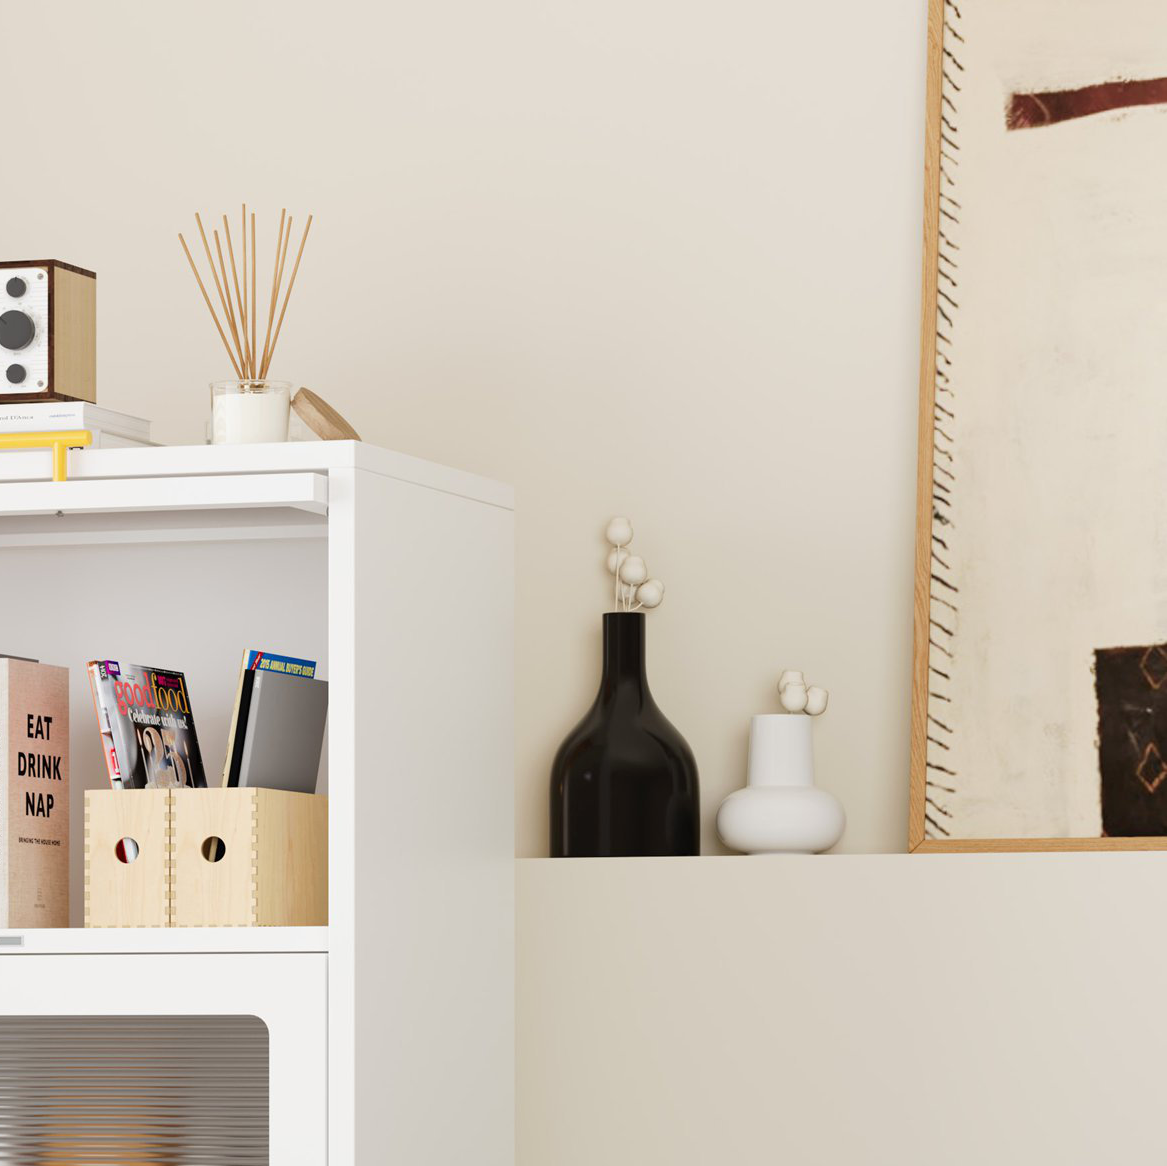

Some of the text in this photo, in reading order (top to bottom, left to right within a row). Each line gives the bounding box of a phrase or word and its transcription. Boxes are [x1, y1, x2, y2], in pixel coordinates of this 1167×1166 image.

[27, 713, 53, 741] EAT
[17, 751, 62, 781] DRINK
[25, 791, 54, 818] NAP
